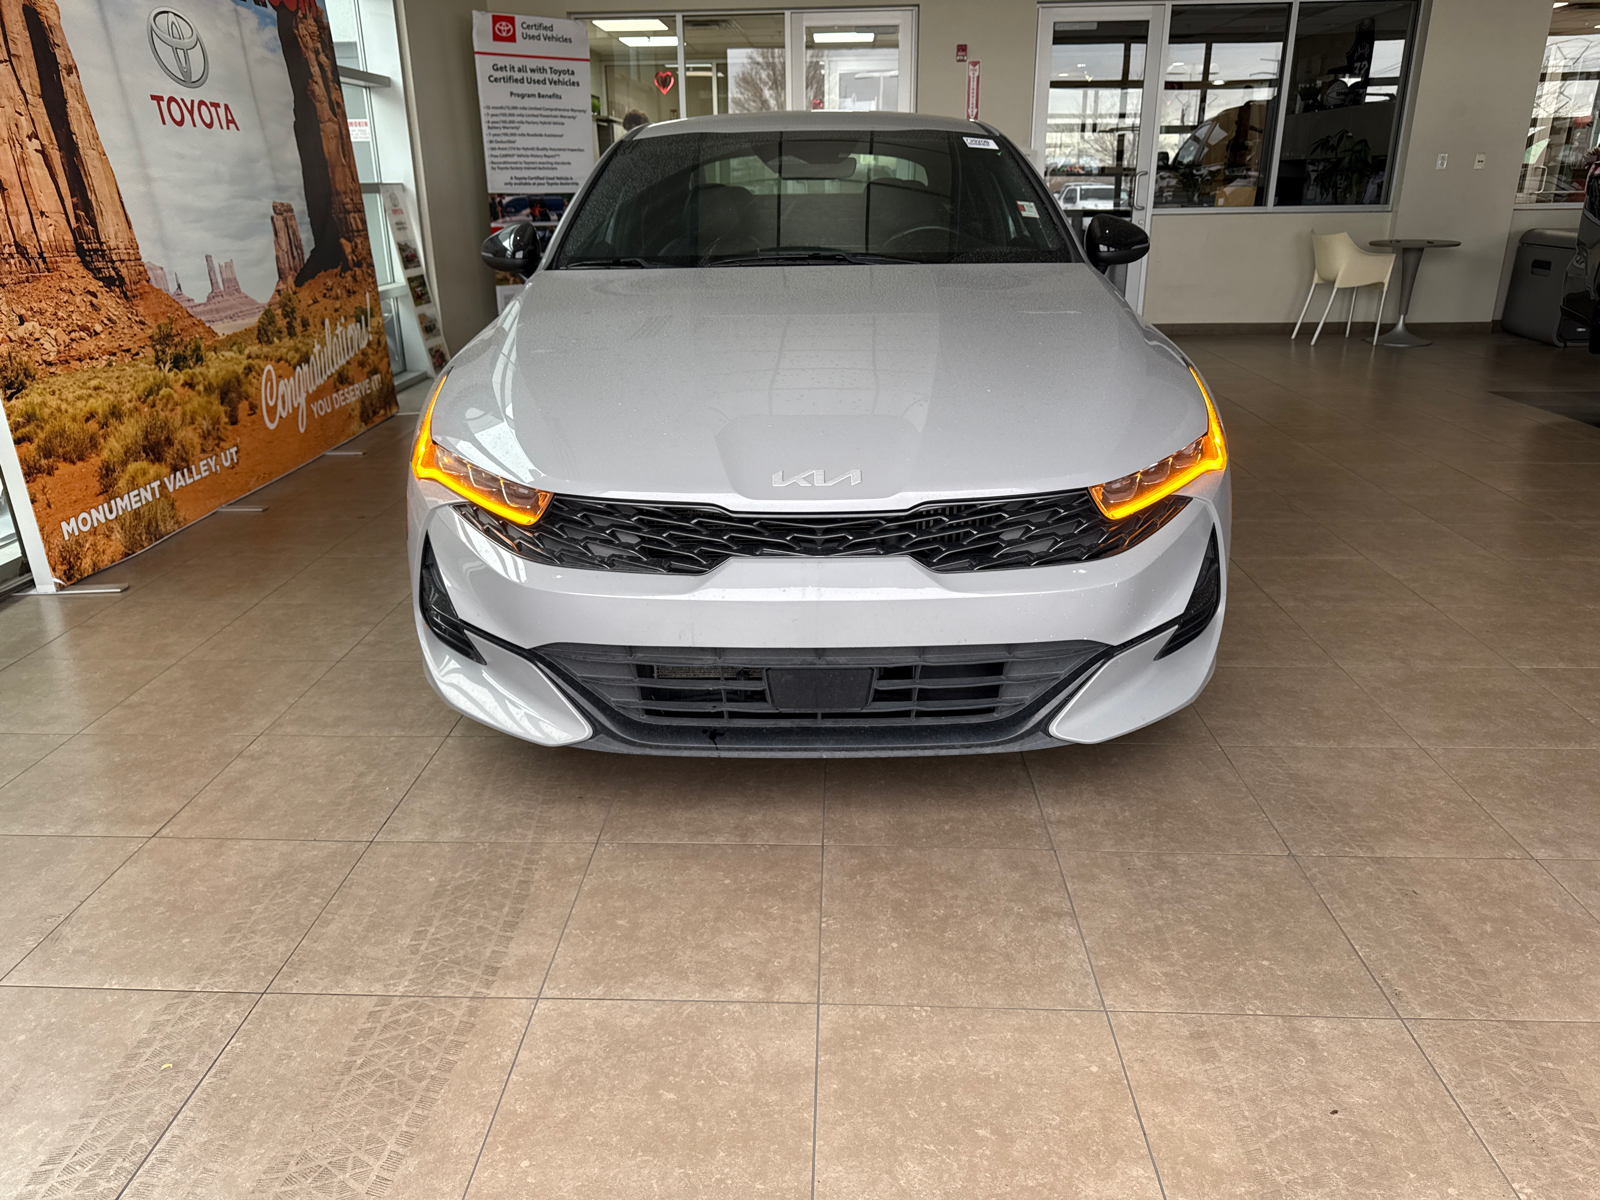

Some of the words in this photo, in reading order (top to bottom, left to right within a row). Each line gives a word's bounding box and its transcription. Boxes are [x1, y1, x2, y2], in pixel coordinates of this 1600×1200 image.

[521, 21, 554, 32] Certified
[522, 32, 541, 41] Used
[542, 34, 573, 44] Vehicles
[492, 63, 508, 73] Get
[509, 64, 516, 73] it
[517, 65, 528, 74] all
[529, 66, 548, 75] with
[549, 67, 575, 77] Toyota
[488, 74, 525, 84] Certified
[526, 76, 547, 86] Used
[548, 77, 580, 87] Vehicles
[510, 91, 537, 100] Program
[538, 92, 562, 100] Benefits
[150, 94, 240, 131] TOYOTA
[261, 292, 372, 433] Congratulations!
[310, 399, 332, 419] YOU
[332, 383, 371, 410] DESERVE
[370, 374, 382, 392] IT!
[772, 468, 862, 487] KIA
[60, 480, 161, 541] MONUMENT
[163, 455, 221, 493] VALLEY,
[220, 446, 239, 469] UT
